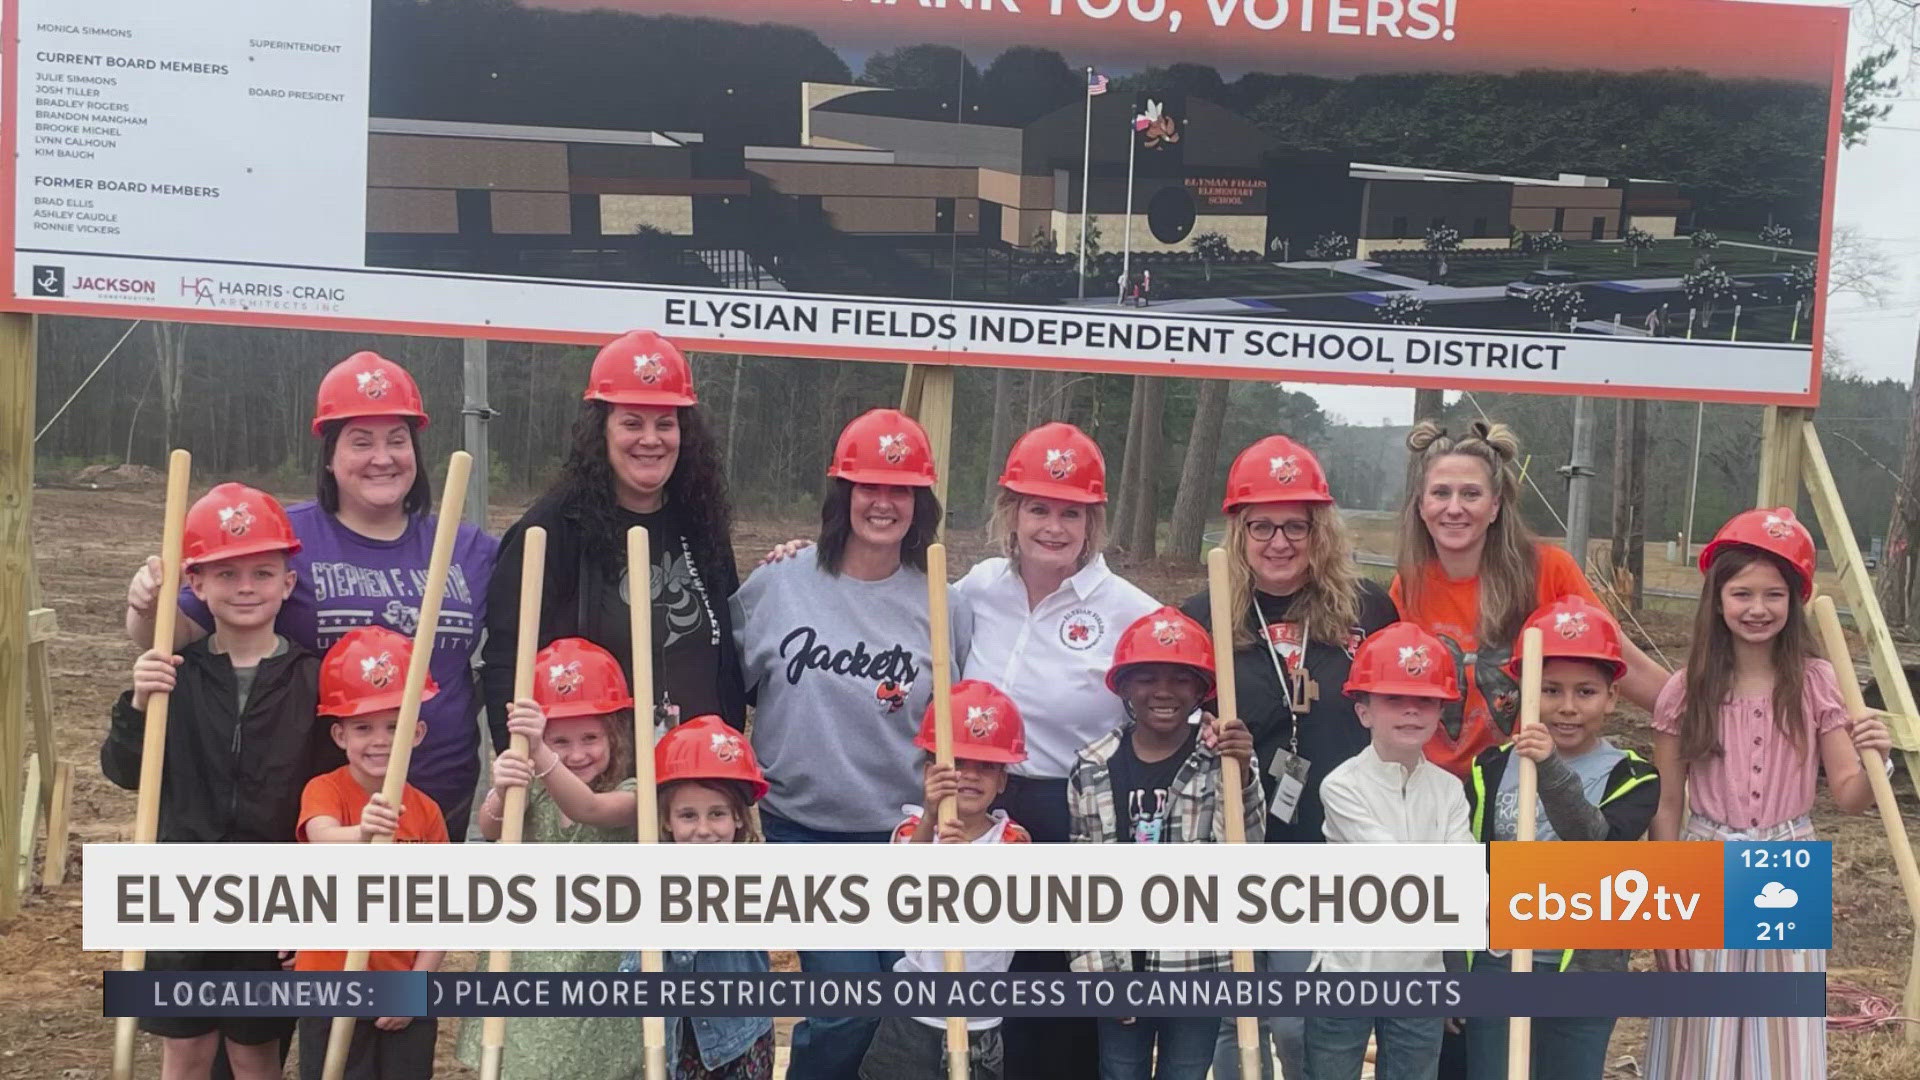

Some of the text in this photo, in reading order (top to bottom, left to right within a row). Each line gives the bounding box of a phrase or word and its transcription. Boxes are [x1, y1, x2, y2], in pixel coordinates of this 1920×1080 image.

[1207, 0, 1456, 41] VOTERS!
[37, 23, 132, 38] MONICA SIMMONS
[249, 39, 342, 53] SUPERINTENDENT
[37, 52, 229, 75] CURRENT BOARD MEMBERS
[36, 73, 117, 86] JULIE SIMMONS
[36, 85, 100, 97] JOSH TILLER
[249, 88, 344, 101] BOARD PRESIDENT
[36, 98, 129, 112] BRADLEY ROGERS
[36, 111, 147, 125] BRANDON MANGHAM
[35, 123, 121, 136] BROOKE MICHEL
[35, 136, 116, 148] LYNN CALHOUN
[35, 148, 94, 159] KIM BAUGH
[35, 176, 219, 197] FORMER BOARD MEMBERS
[34, 197, 94, 208] BRAD ELLIS
[34, 210, 118, 222] ASHLEY CAUDLE
[34, 222, 120, 234] RONNIE VICKERS
[73, 276, 156, 294] JACKSON
[219, 282, 344, 301] HARRIS CRAIG
[220, 299, 340, 312] ARCHITECTS INC
[665, 299, 1566, 370] ELYSIAN FIELDS INDEPENDENT SCHOOL DISTRICT
[312, 562, 394, 601] STEPHEN
[780, 626, 919, 685] Jackets
